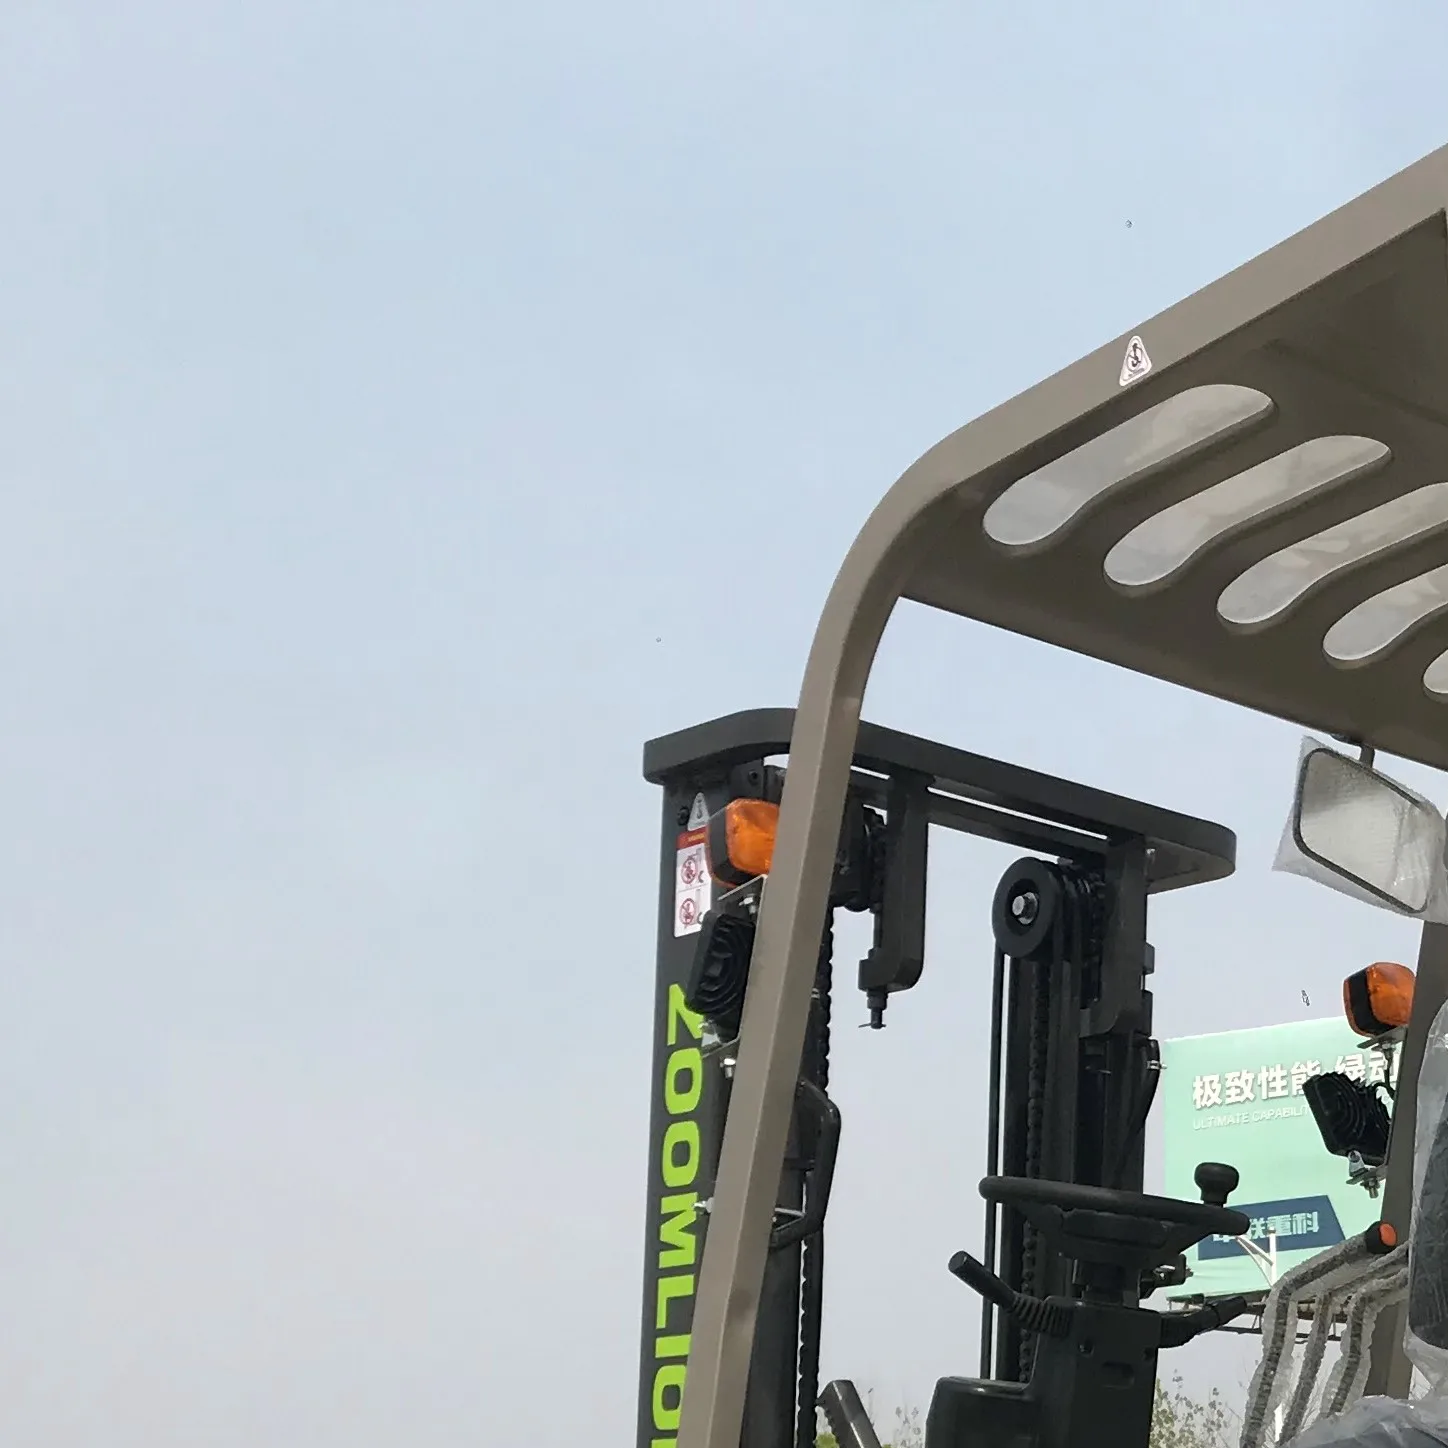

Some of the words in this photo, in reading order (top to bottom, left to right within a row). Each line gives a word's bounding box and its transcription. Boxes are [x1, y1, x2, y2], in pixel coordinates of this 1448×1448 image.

[1192, 1060, 1322, 1109] 极致性能
[1193, 1112, 1250, 1131] ULTIMATE
[1213, 1211, 1320, 1243] 联重科
